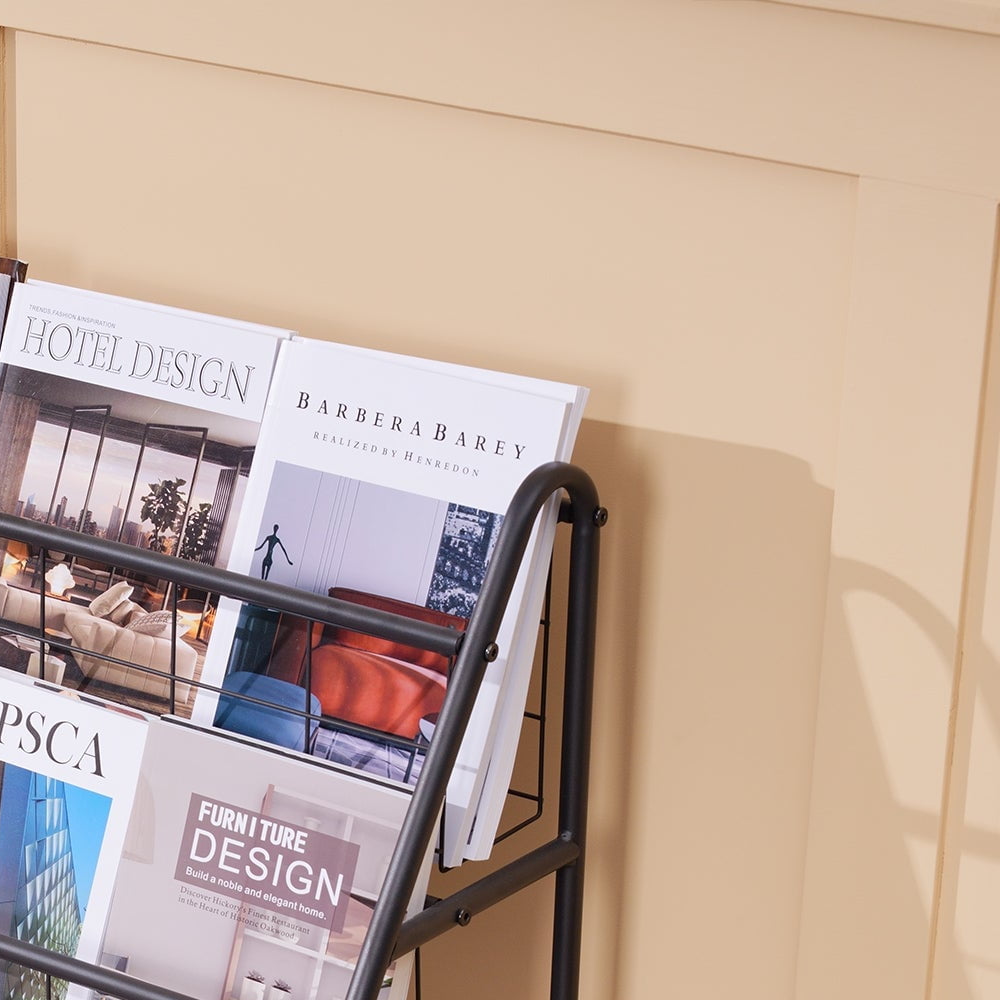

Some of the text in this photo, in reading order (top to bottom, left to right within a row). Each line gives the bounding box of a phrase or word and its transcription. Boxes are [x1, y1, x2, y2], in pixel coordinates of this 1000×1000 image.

[20, 316, 255, 403] HOTEL DESIGN
[296, 391, 526, 460] BARBERA BAREY
[313, 431, 377, 453] REALIZED
[382, 447, 398, 458] BY
[185, 866, 327, 920] Build a noble and elegant home.
[189, 827, 344, 907] DESIGN
[180, 886, 211, 902] Discover
[271, 915, 311, 935] Restaurant
[186, 898, 199, 908] the
